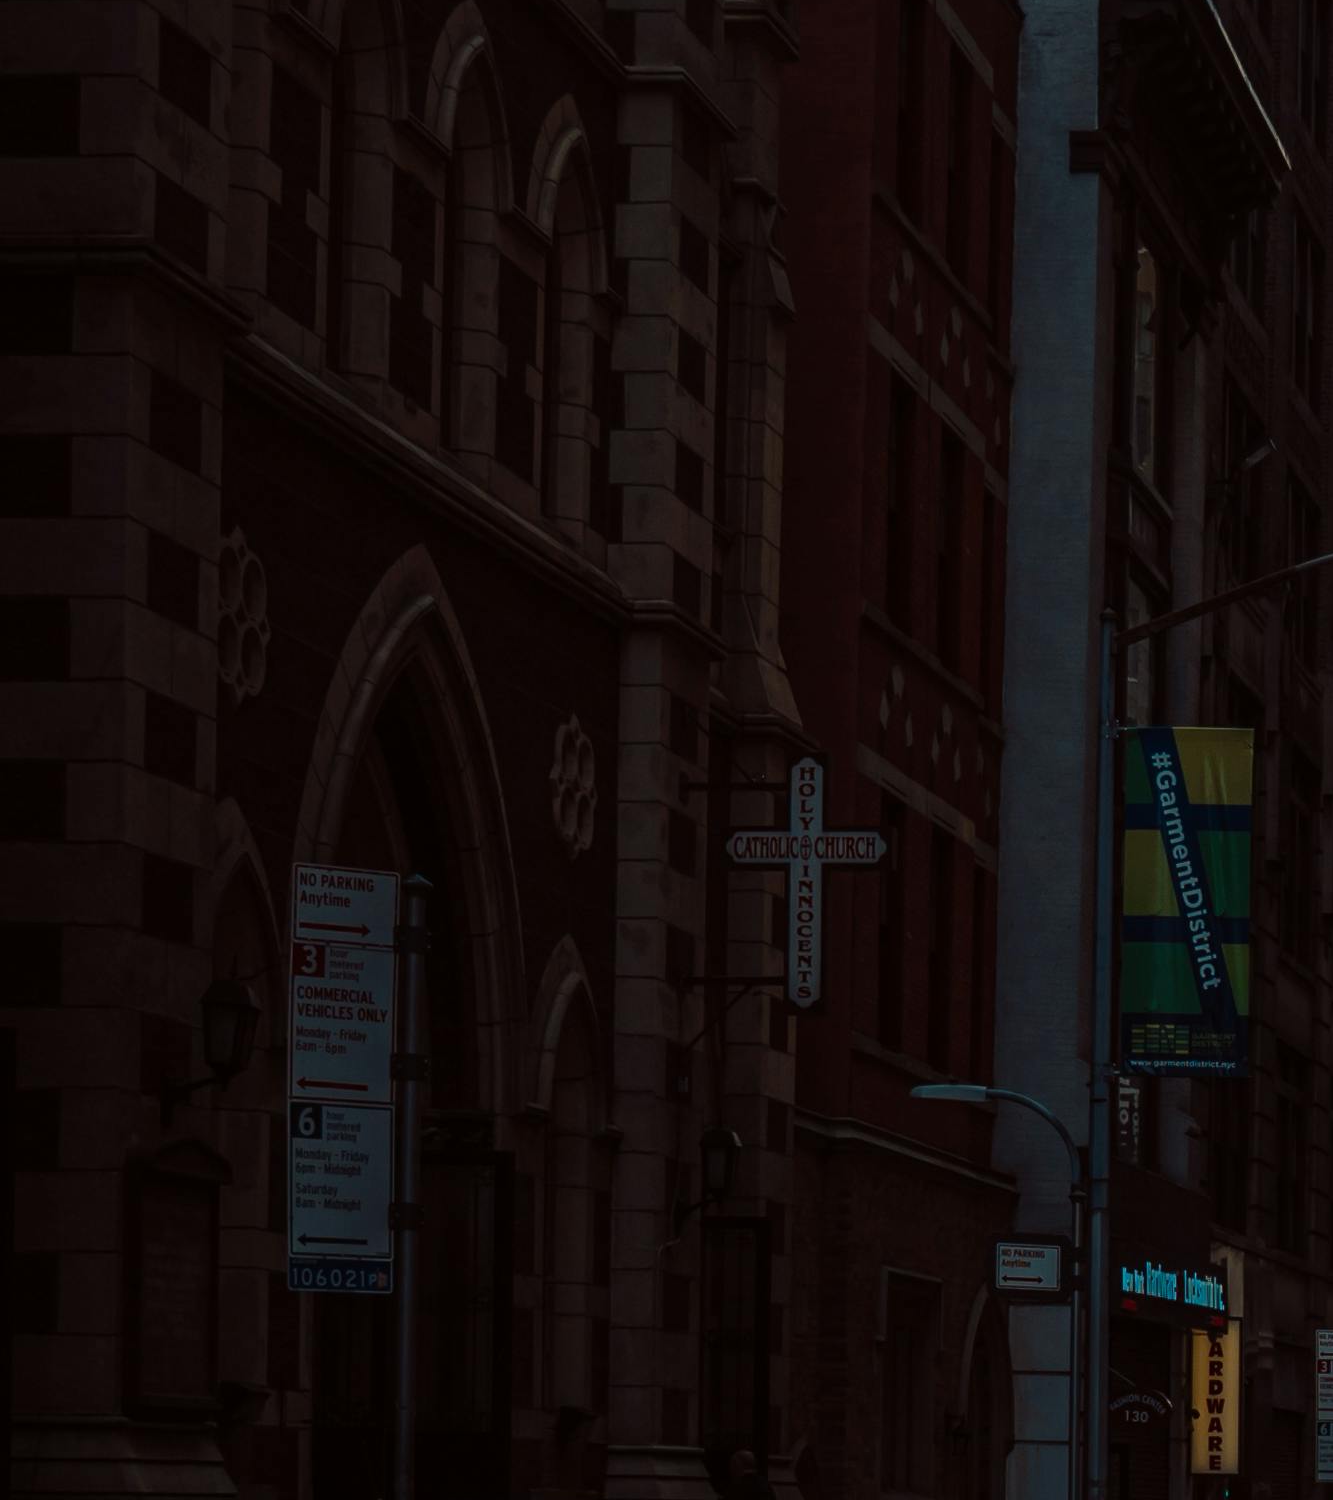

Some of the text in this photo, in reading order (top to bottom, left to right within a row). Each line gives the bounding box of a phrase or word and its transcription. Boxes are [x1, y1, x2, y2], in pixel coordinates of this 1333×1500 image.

[799, 766, 816, 832] HOLY
[734, 836, 877, 859] CATHOLIC CHURCH
[1151, 750, 1222, 991] #GarmentDistrict
[299, 872, 375, 893] NO PARKING
[299, 890, 351, 908] Anytime
[796, 865, 814, 998] INNOCENTS
[301, 945, 319, 976] 3
[296, 985, 376, 1005] COMMERCIAL
[296, 1002, 388, 1023] VEHICLES ONLY
[296, 1025, 368, 1043] Monday Friday
[298, 1106, 317, 1137] 6
[295, 1147, 370, 1164] Monday Friday
[295, 1182, 338, 1197] Saturday
[292, 1267, 367, 1289] 106021
[1205, 1336, 1226, 1471] ARDWARE
[1125, 1409, 1150, 1423] 130
